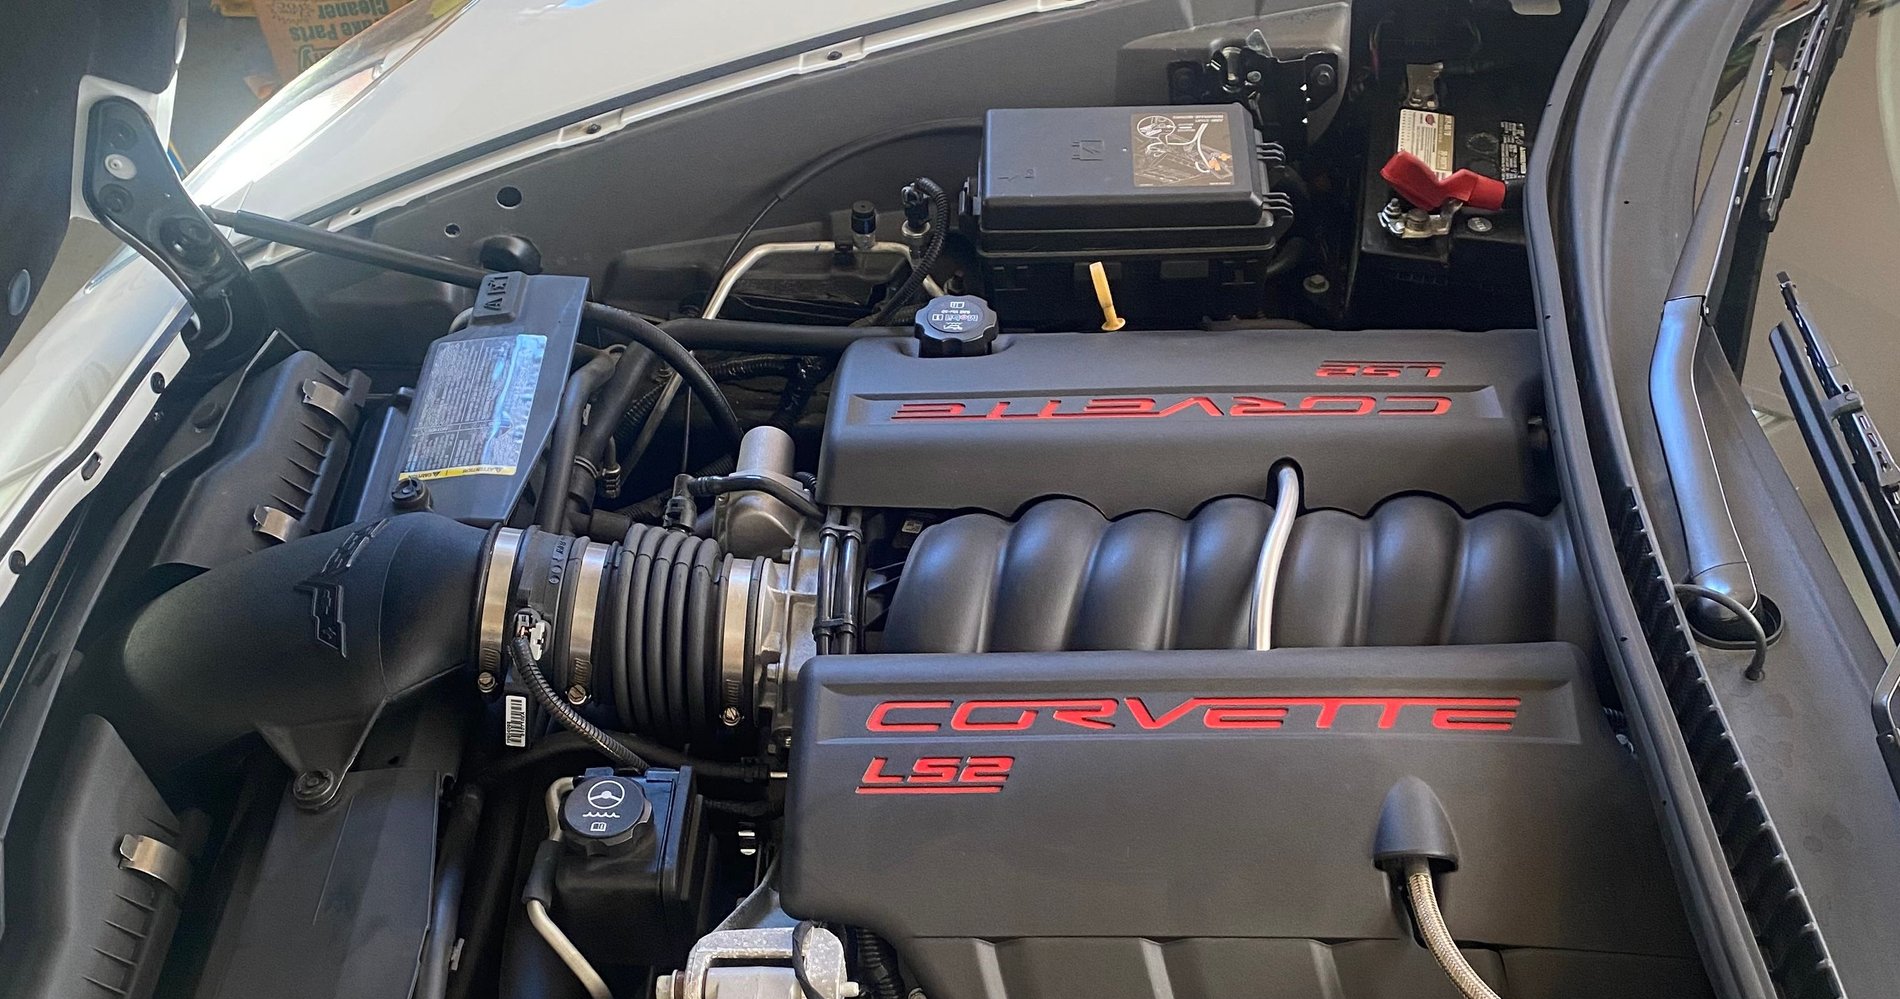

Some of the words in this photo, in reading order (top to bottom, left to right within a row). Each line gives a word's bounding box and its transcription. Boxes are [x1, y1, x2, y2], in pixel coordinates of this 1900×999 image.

[318, 0, 389, 19] Cleaner
[289, 24, 338, 42] Parts
[1316, 360, 1446, 380] LS2
[892, 395, 1453, 421] CORVETTE
[866, 695, 1522, 734] CORVETTE
[856, 755, 1015, 795] LS2
